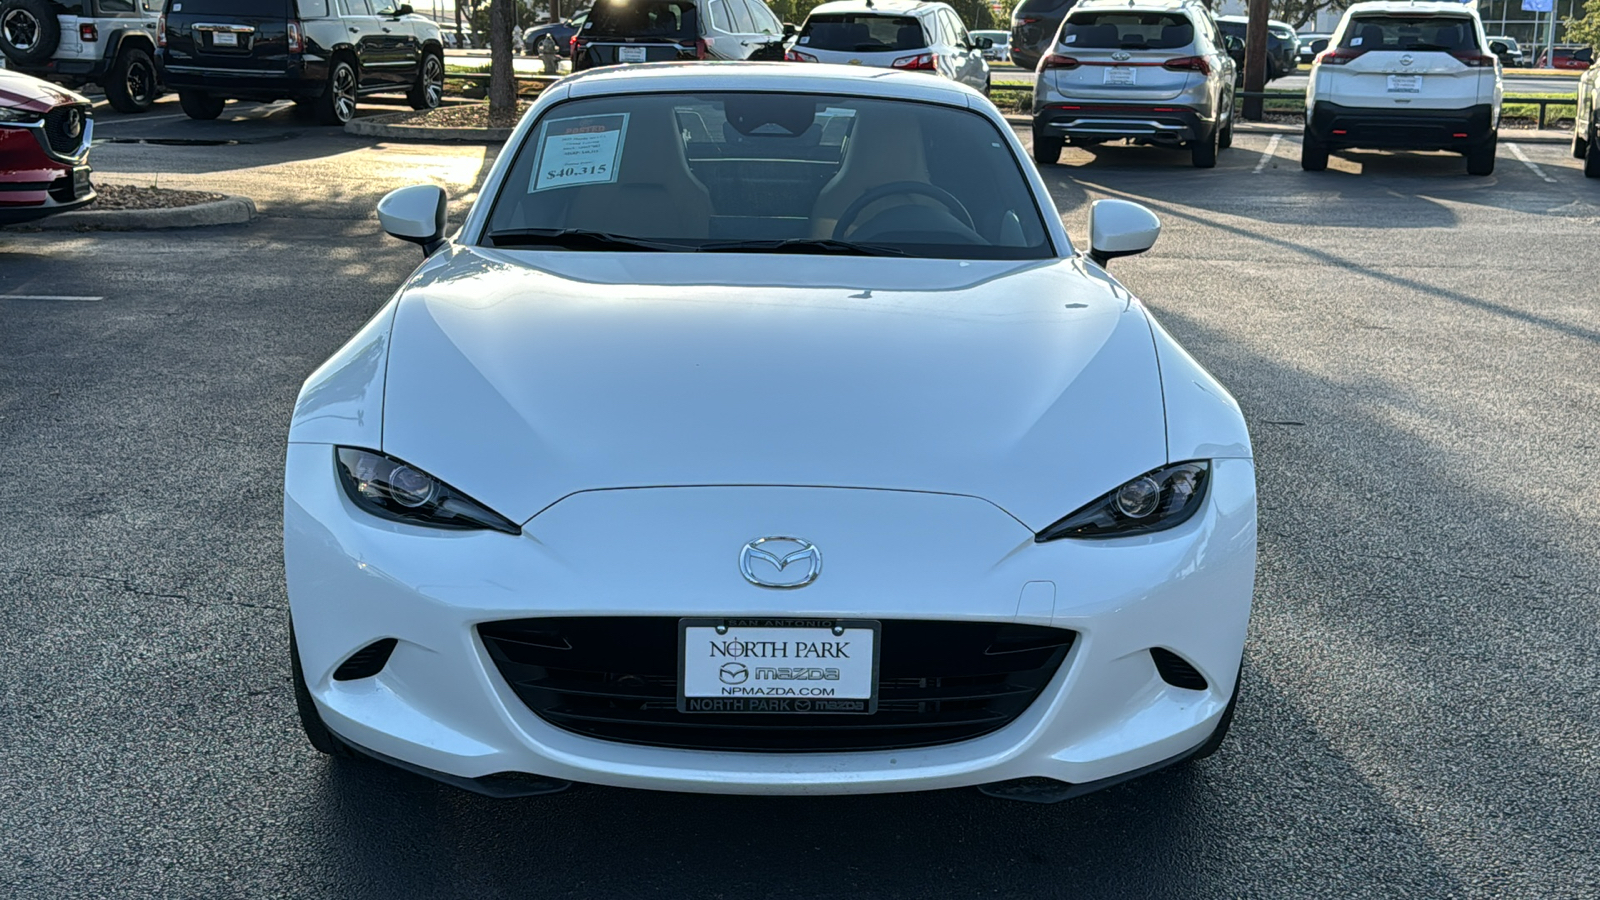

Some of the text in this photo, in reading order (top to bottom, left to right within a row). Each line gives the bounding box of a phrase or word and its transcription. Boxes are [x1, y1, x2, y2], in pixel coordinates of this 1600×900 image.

[728, 619, 833, 627] SAN ANTONIO
[709, 640, 850, 659] NORTH PARK
[755, 667, 840, 681] mazda
[721, 687, 835, 696] NPMAZDA.COM
[690, 699, 744, 711] NORTH
[749, 699, 791, 711] PARK
